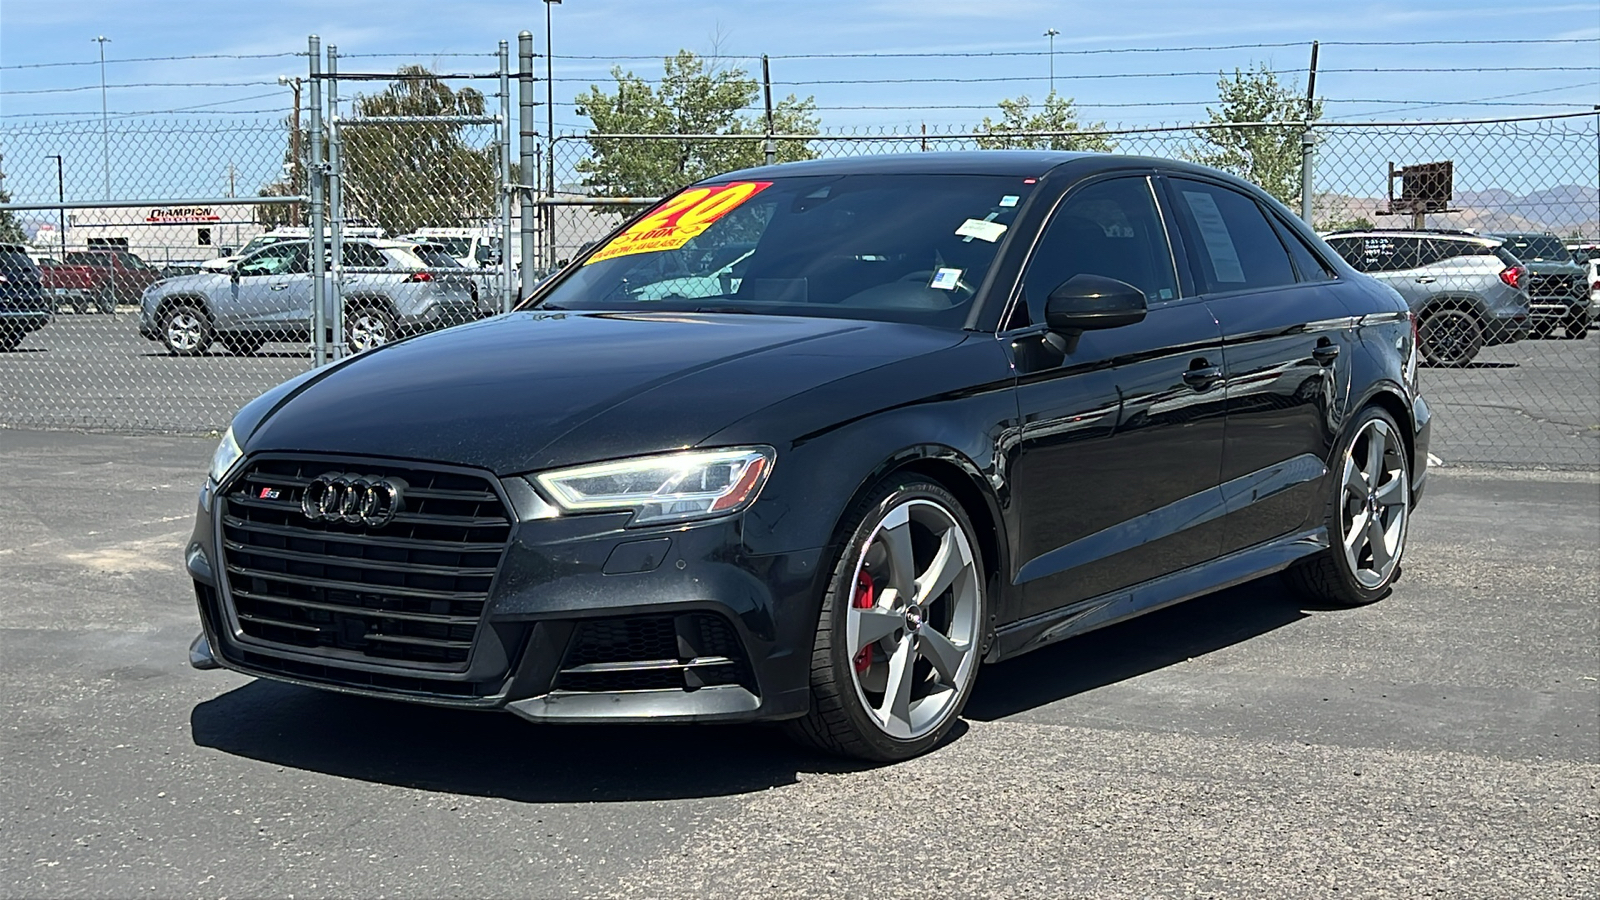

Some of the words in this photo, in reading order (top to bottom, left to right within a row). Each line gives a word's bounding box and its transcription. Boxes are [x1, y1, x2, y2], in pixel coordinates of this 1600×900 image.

[150, 207, 212, 218] CHAMPION
[625, 183, 756, 234] 20
[632, 226, 681, 243] LOOK
